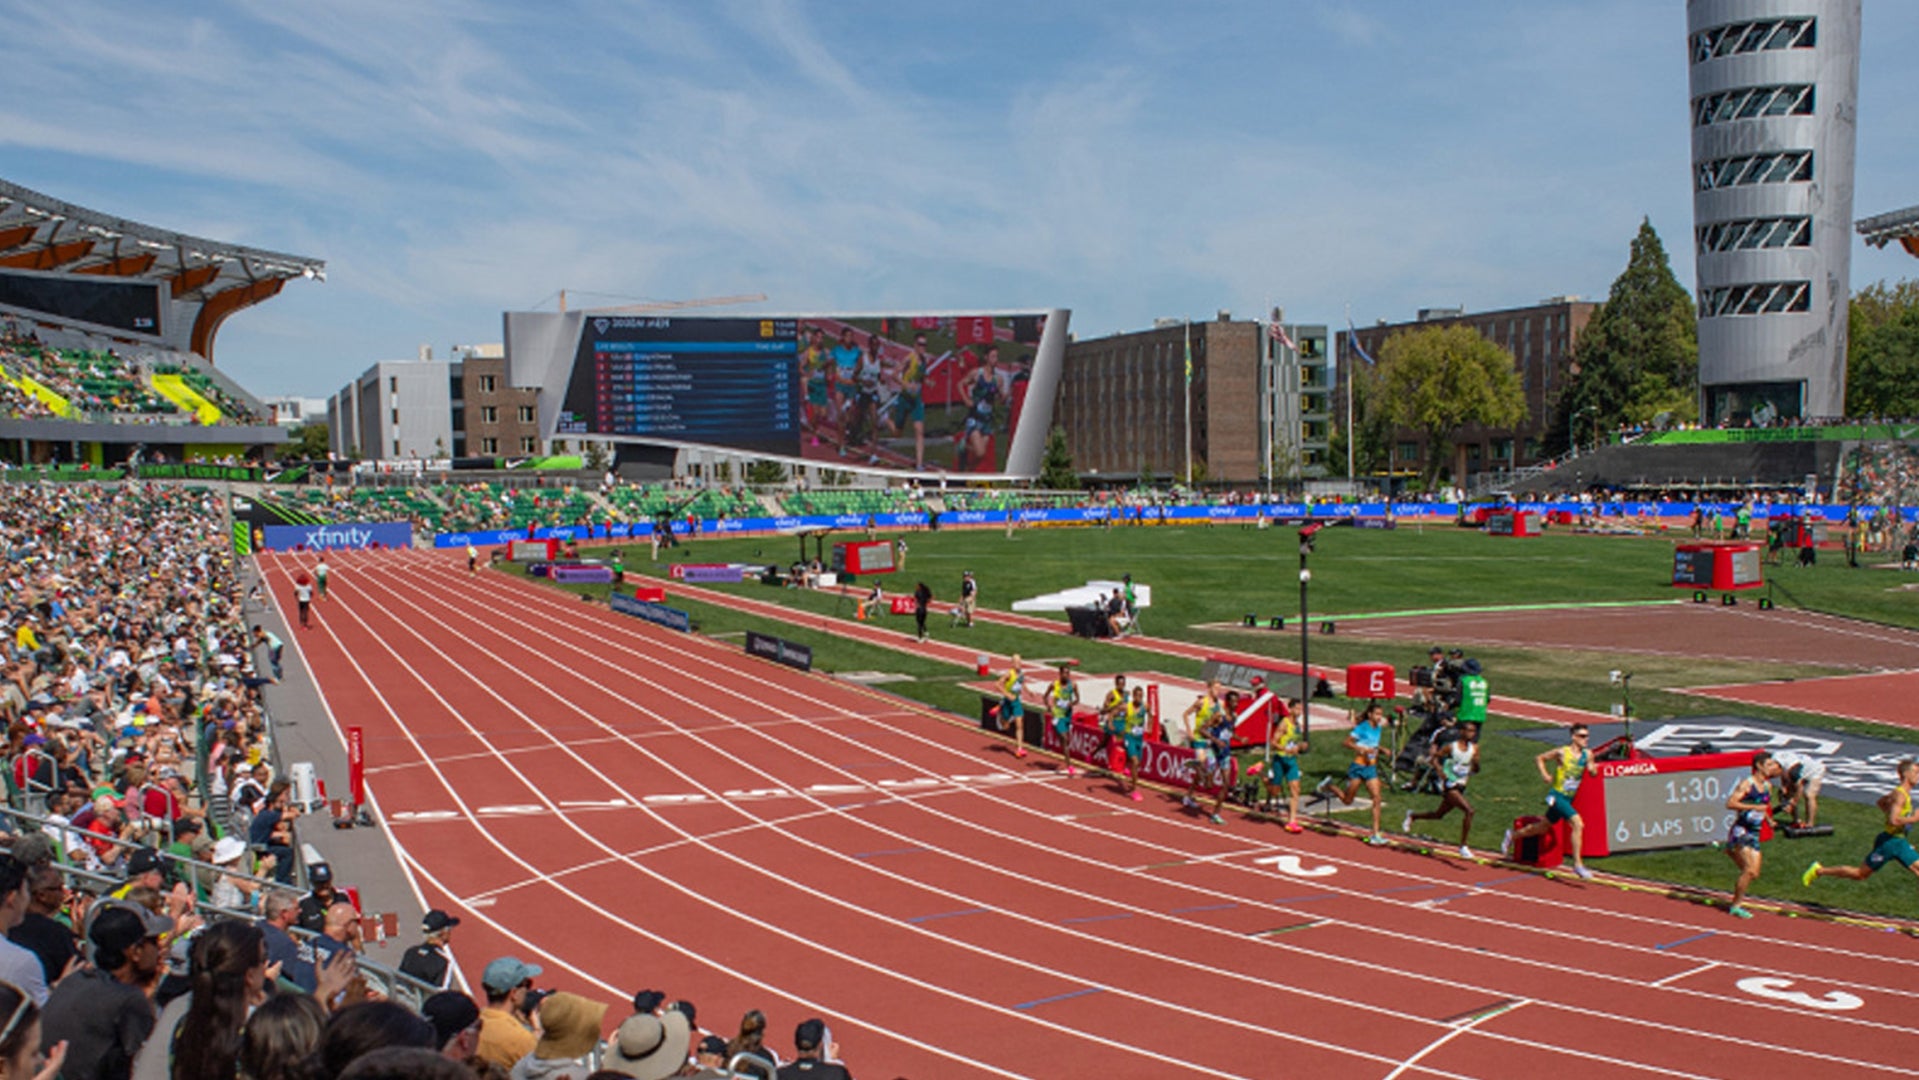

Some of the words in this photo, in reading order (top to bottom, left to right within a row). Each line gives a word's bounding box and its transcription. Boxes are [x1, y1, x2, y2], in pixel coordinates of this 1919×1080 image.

[306, 526, 372, 550] xfinity
[1369, 671, 1384, 692] 6
[1616, 764, 1658, 776] OMEGA
[1615, 820, 1630, 842] 6
[1641, 818, 1683, 838] LAPS
[1691, 816, 1714, 833] TO
[1253, 854, 1338, 877] 2
[1735, 976, 1865, 1010] 3
